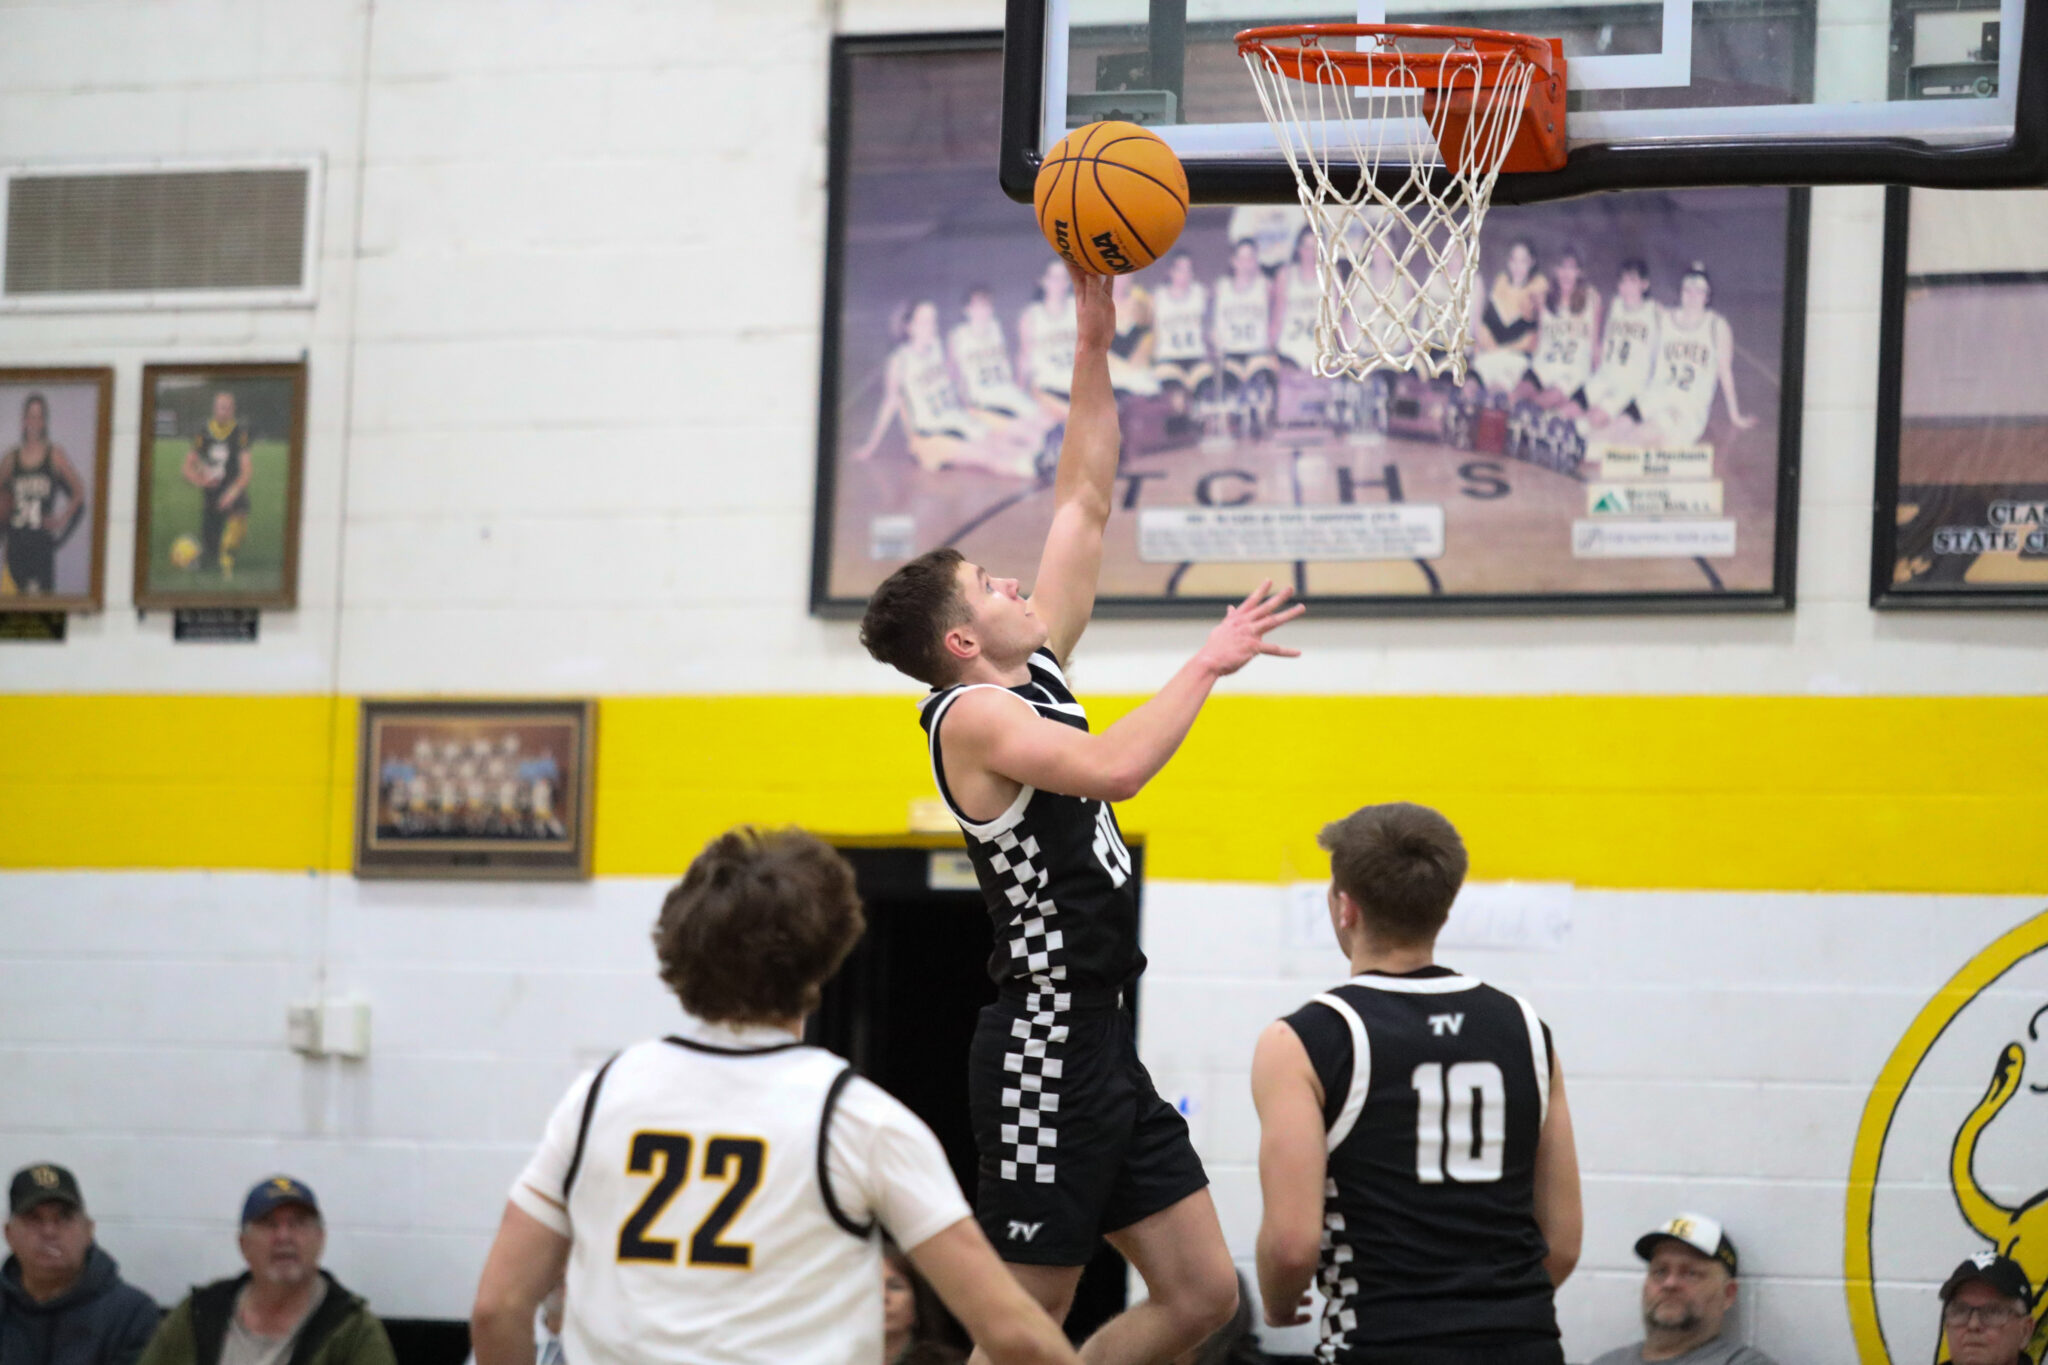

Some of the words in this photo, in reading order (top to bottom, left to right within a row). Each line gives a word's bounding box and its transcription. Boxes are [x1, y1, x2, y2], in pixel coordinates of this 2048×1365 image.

[1936, 531, 2018, 550] STATE
[1428, 1013, 1465, 1036] TV
[1411, 1061, 1506, 1184] 10
[615, 1129, 770, 1270] 22
[1007, 1219, 1045, 1242] TV
